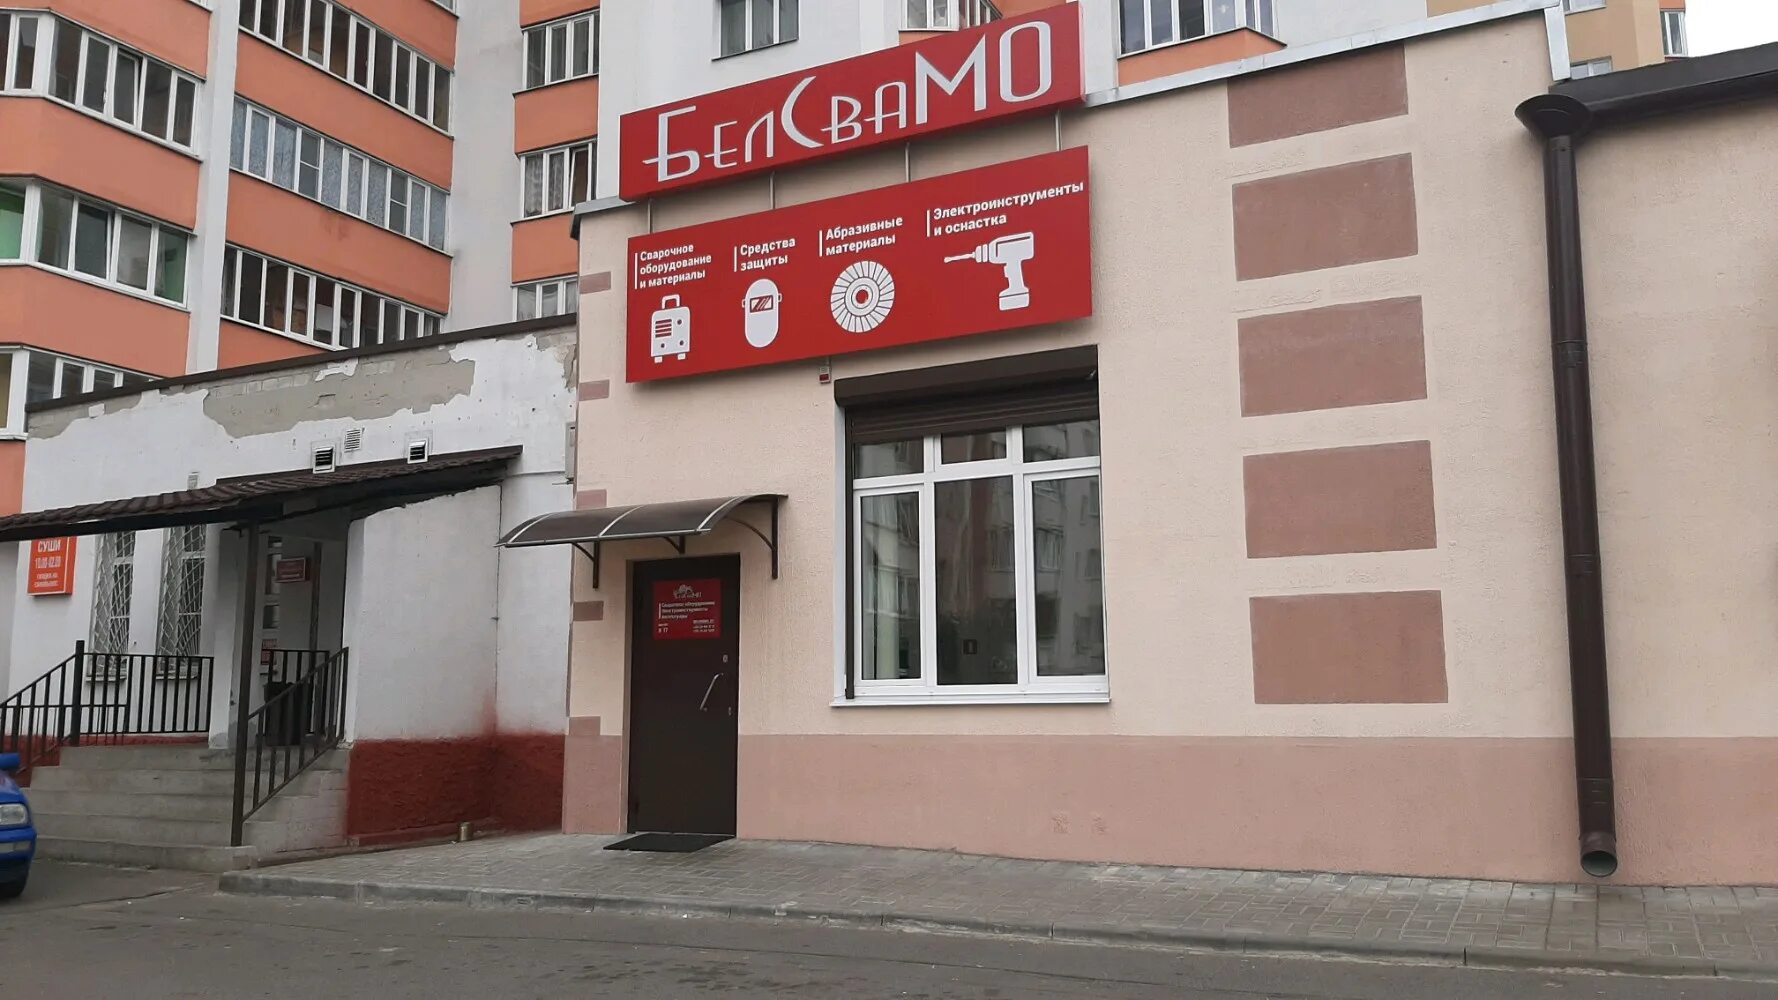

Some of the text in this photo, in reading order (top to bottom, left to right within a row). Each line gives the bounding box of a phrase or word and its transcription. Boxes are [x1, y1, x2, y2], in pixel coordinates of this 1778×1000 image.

[933, 181, 1084, 220] Электроинструменты
[826, 215, 903, 242] Абразивные
[933, 214, 1007, 236] и оснастка
[640, 245, 694, 262] Сварочное
[740, 237, 796, 257] Средства
[826, 234, 896, 256] материалы
[639, 254, 712, 275] оборудование
[740, 254, 788, 271] защиты
[639, 270, 706, 289] и материалы
[38, 540, 61, 552] СУШИ
